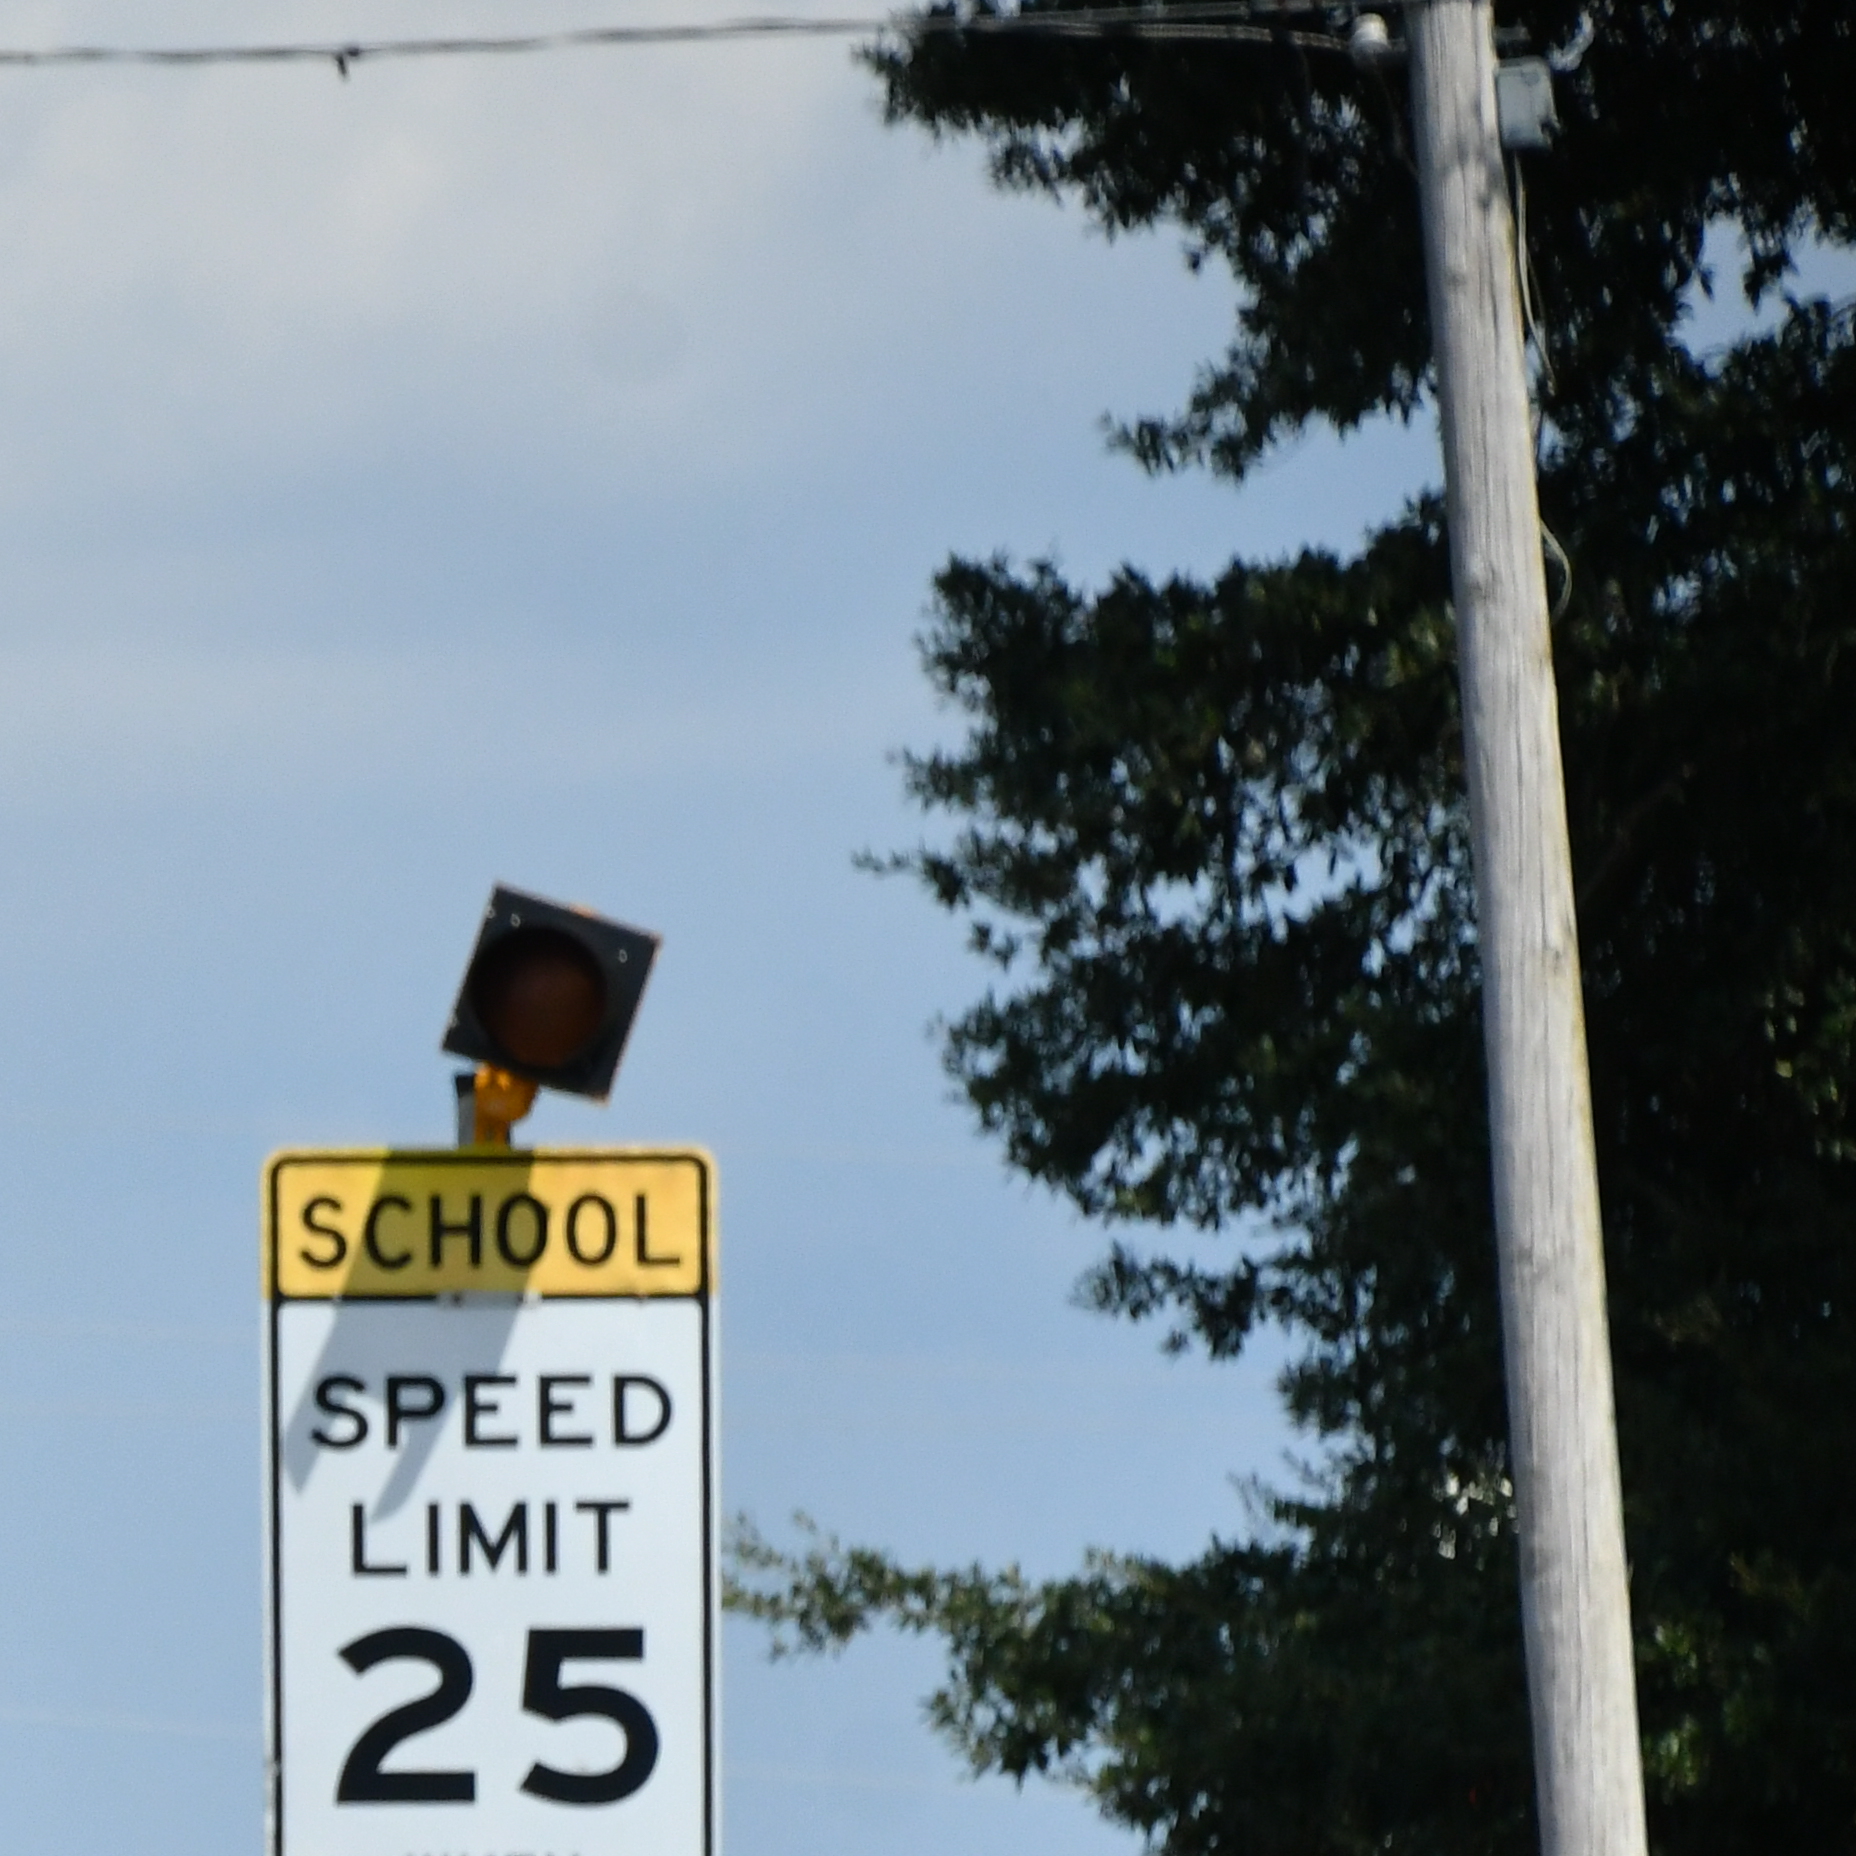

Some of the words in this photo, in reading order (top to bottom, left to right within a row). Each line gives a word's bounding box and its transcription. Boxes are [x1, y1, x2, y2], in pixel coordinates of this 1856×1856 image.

[299, 1187, 682, 1272] SCHOOL
[309, 1372, 674, 1450] SPEED
[349, 1501, 631, 1577] LIMIT
[335, 1625, 661, 1807] 25
